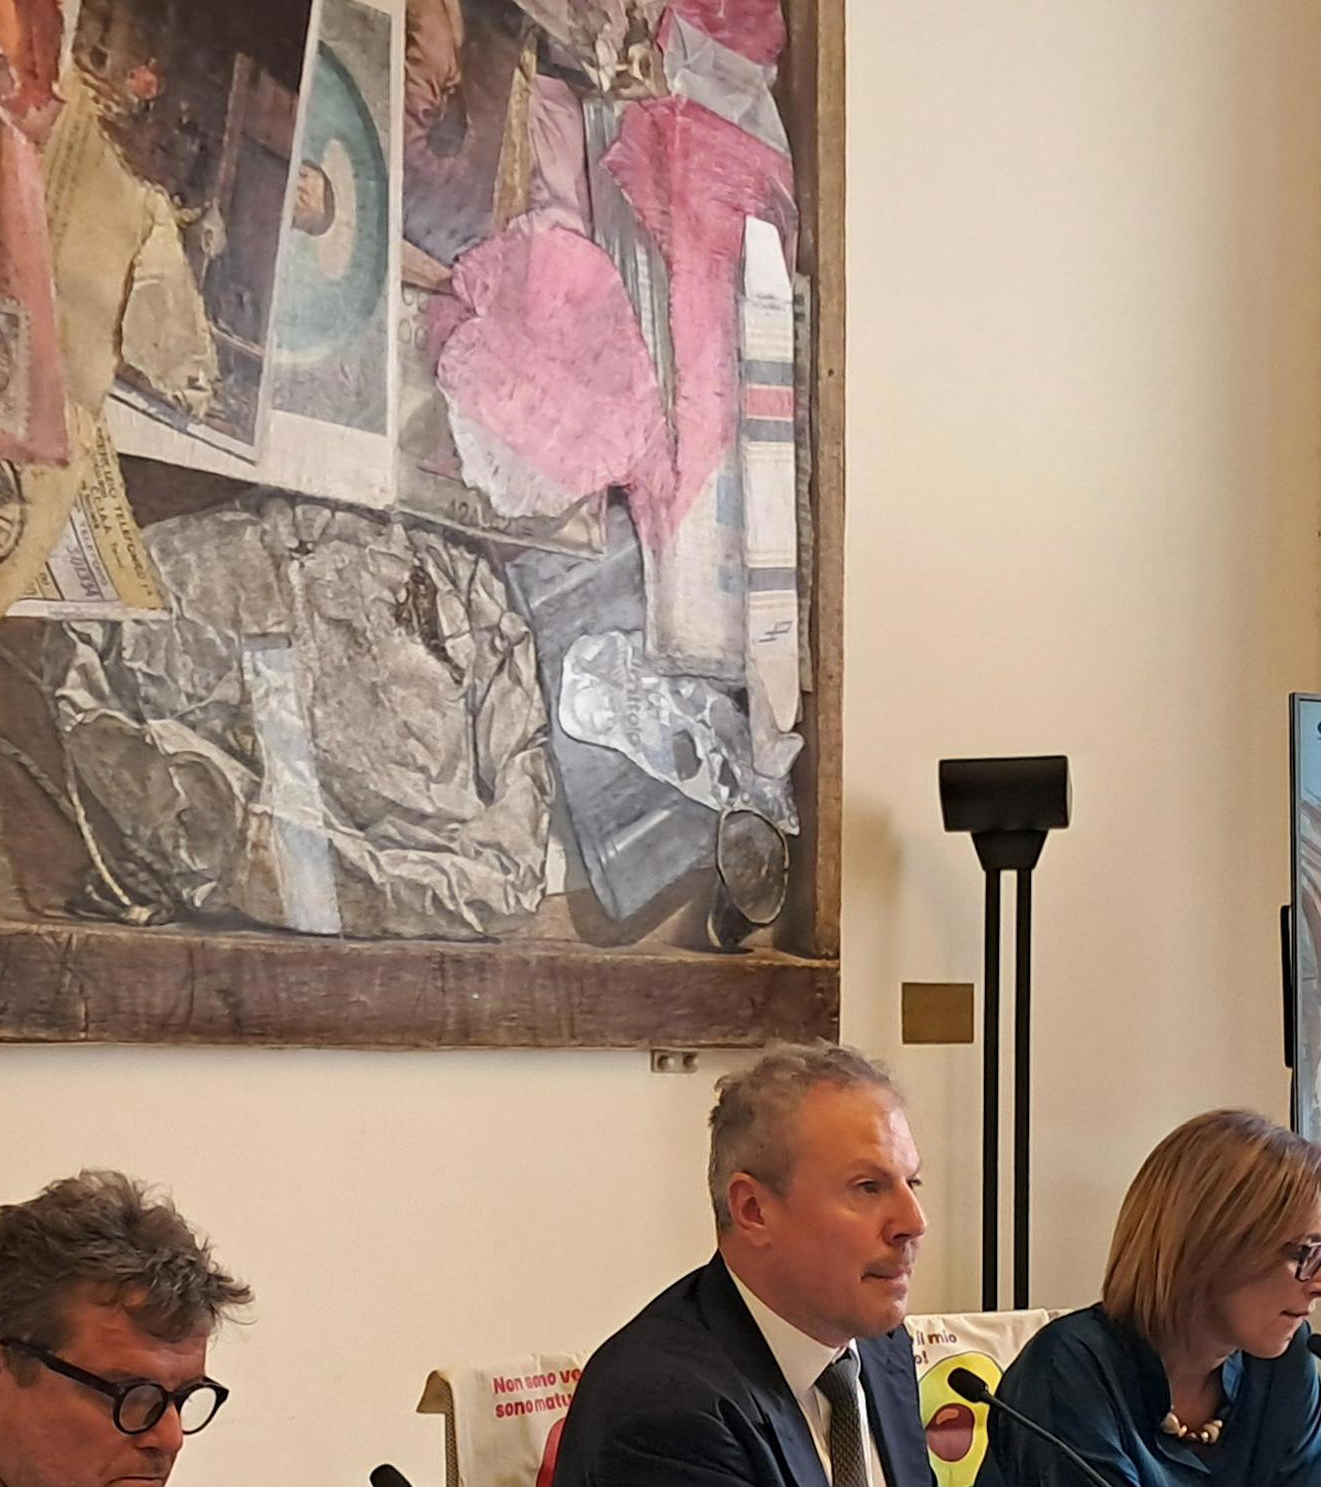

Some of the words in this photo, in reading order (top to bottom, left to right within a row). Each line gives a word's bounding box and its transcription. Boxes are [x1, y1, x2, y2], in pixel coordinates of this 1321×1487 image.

[927, 1331, 957, 1344] mio
[493, 1376, 524, 1394] Non
[495, 1400, 533, 1418] sono
